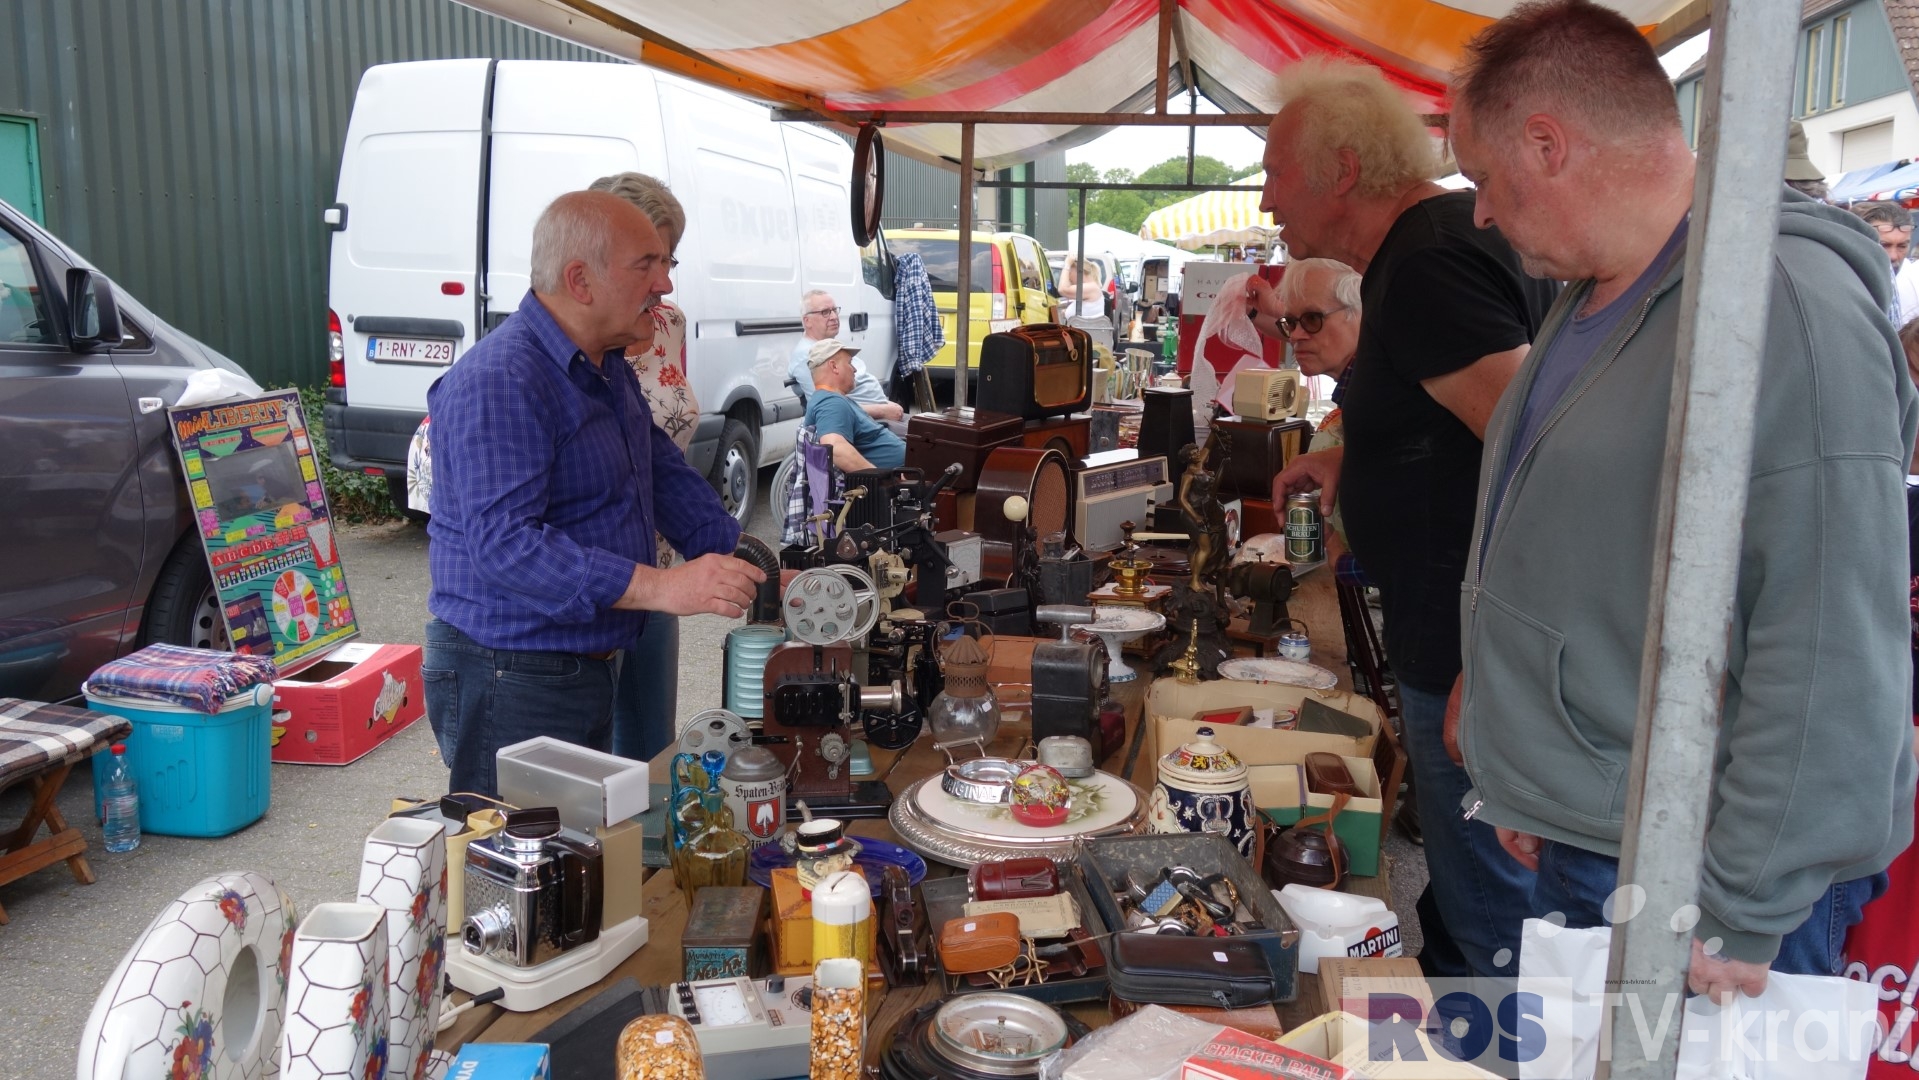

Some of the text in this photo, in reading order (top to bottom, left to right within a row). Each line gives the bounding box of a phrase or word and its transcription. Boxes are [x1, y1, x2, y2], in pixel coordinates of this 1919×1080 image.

[200, 399, 286, 433] LIBERTY
[1286, 524, 1318, 532] SCHULTEN
[1349, 928, 1398, 957] MARTINI
[1204, 1042, 1285, 1072] CRACKER
